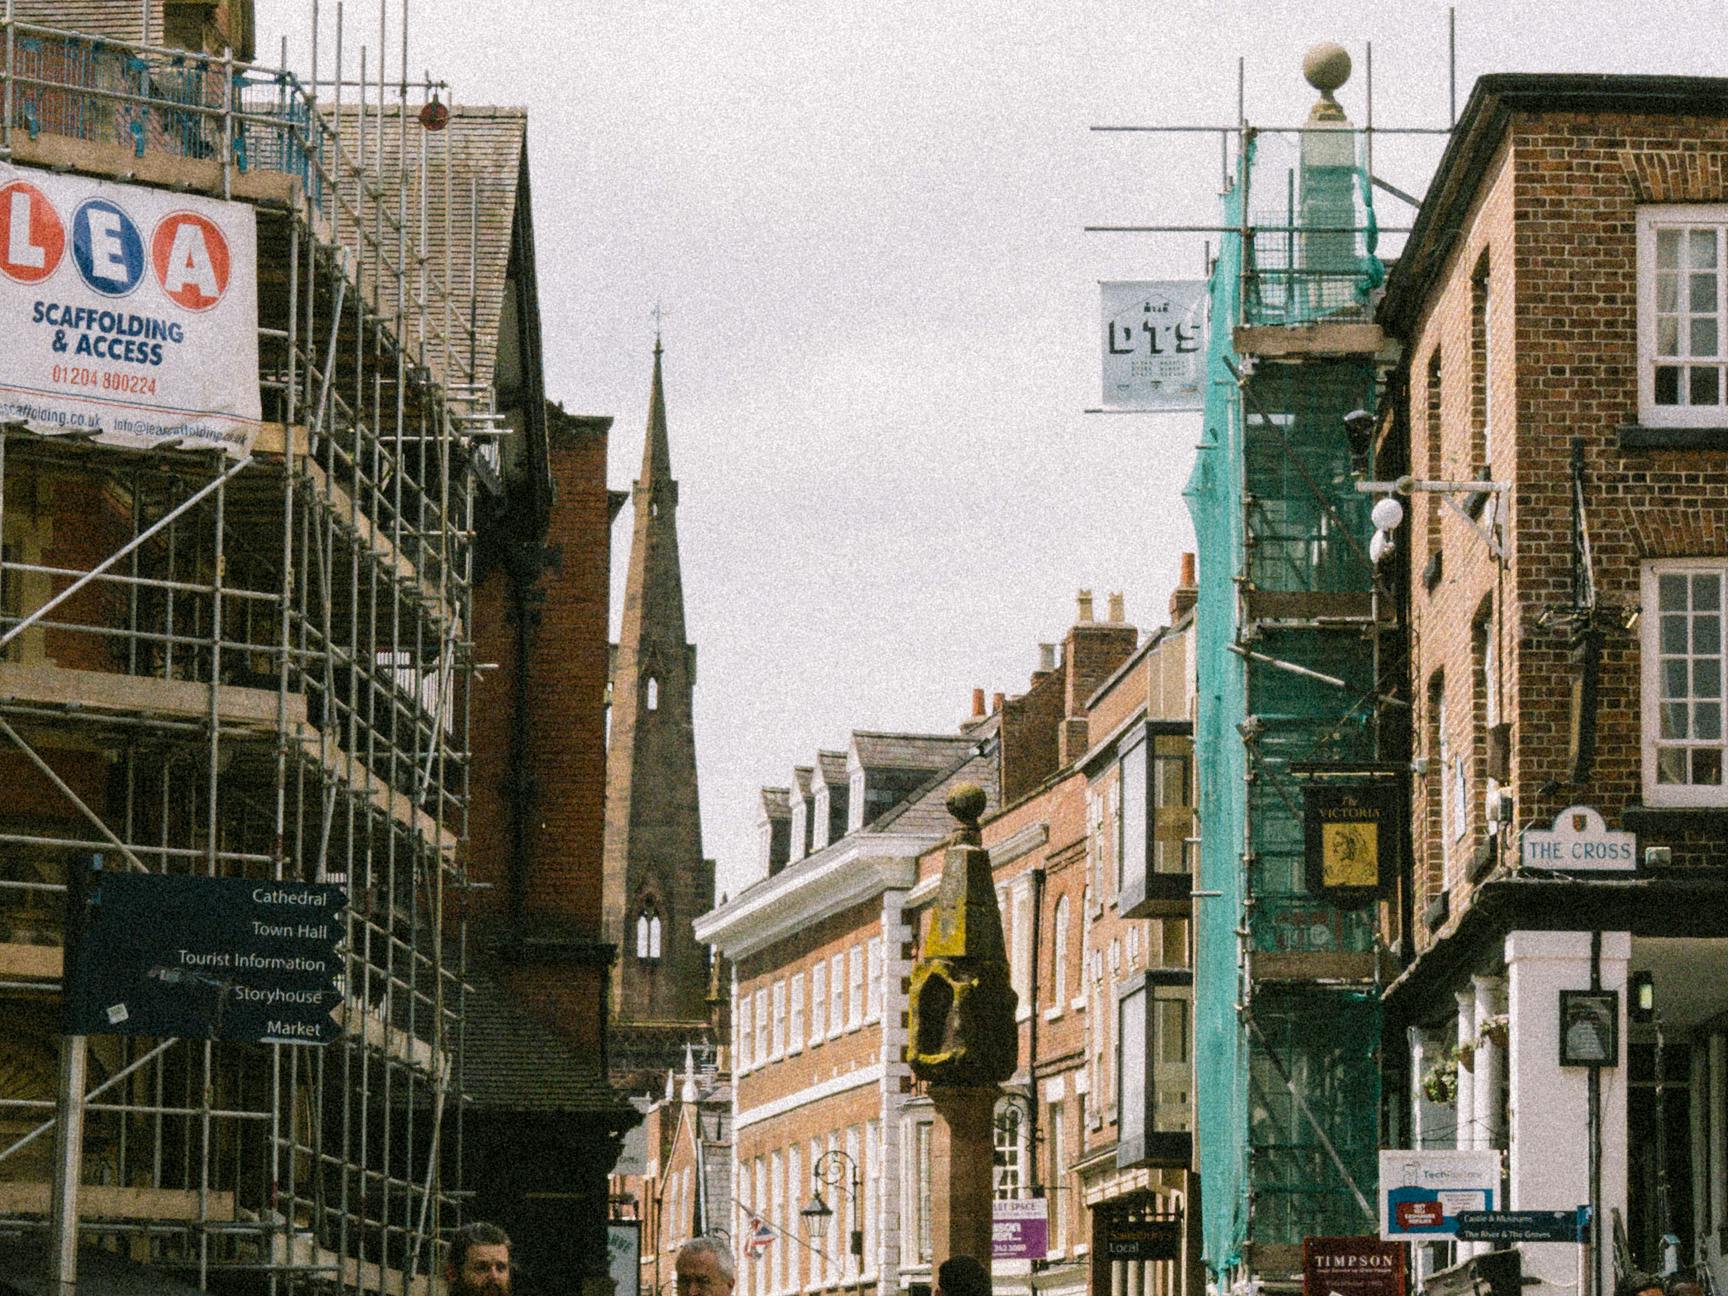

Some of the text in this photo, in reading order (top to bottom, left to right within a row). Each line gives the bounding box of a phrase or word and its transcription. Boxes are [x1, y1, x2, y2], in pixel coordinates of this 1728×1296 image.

[8, 191, 222, 298] LEA
[32, 301, 183, 344] SCAFFOLDING
[52, 330, 163, 367] & ACCESS
[51, 363, 98, 386] 01204
[1320, 807, 1381, 819] VICTORIA
[1529, 841, 1632, 860] THE CROSS
[252, 888, 328, 906] Cathedral
[253, 921, 328, 940] Town Hall
[179, 949, 327, 973] Tourist Information
[234, 984, 324, 1005] Storyhouse
[266, 1020, 321, 1038] Market
[1480, 1230, 1500, 1239] River
[1109, 1241, 1139, 1253] Local
[1315, 1255, 1394, 1268] TIMPSON
